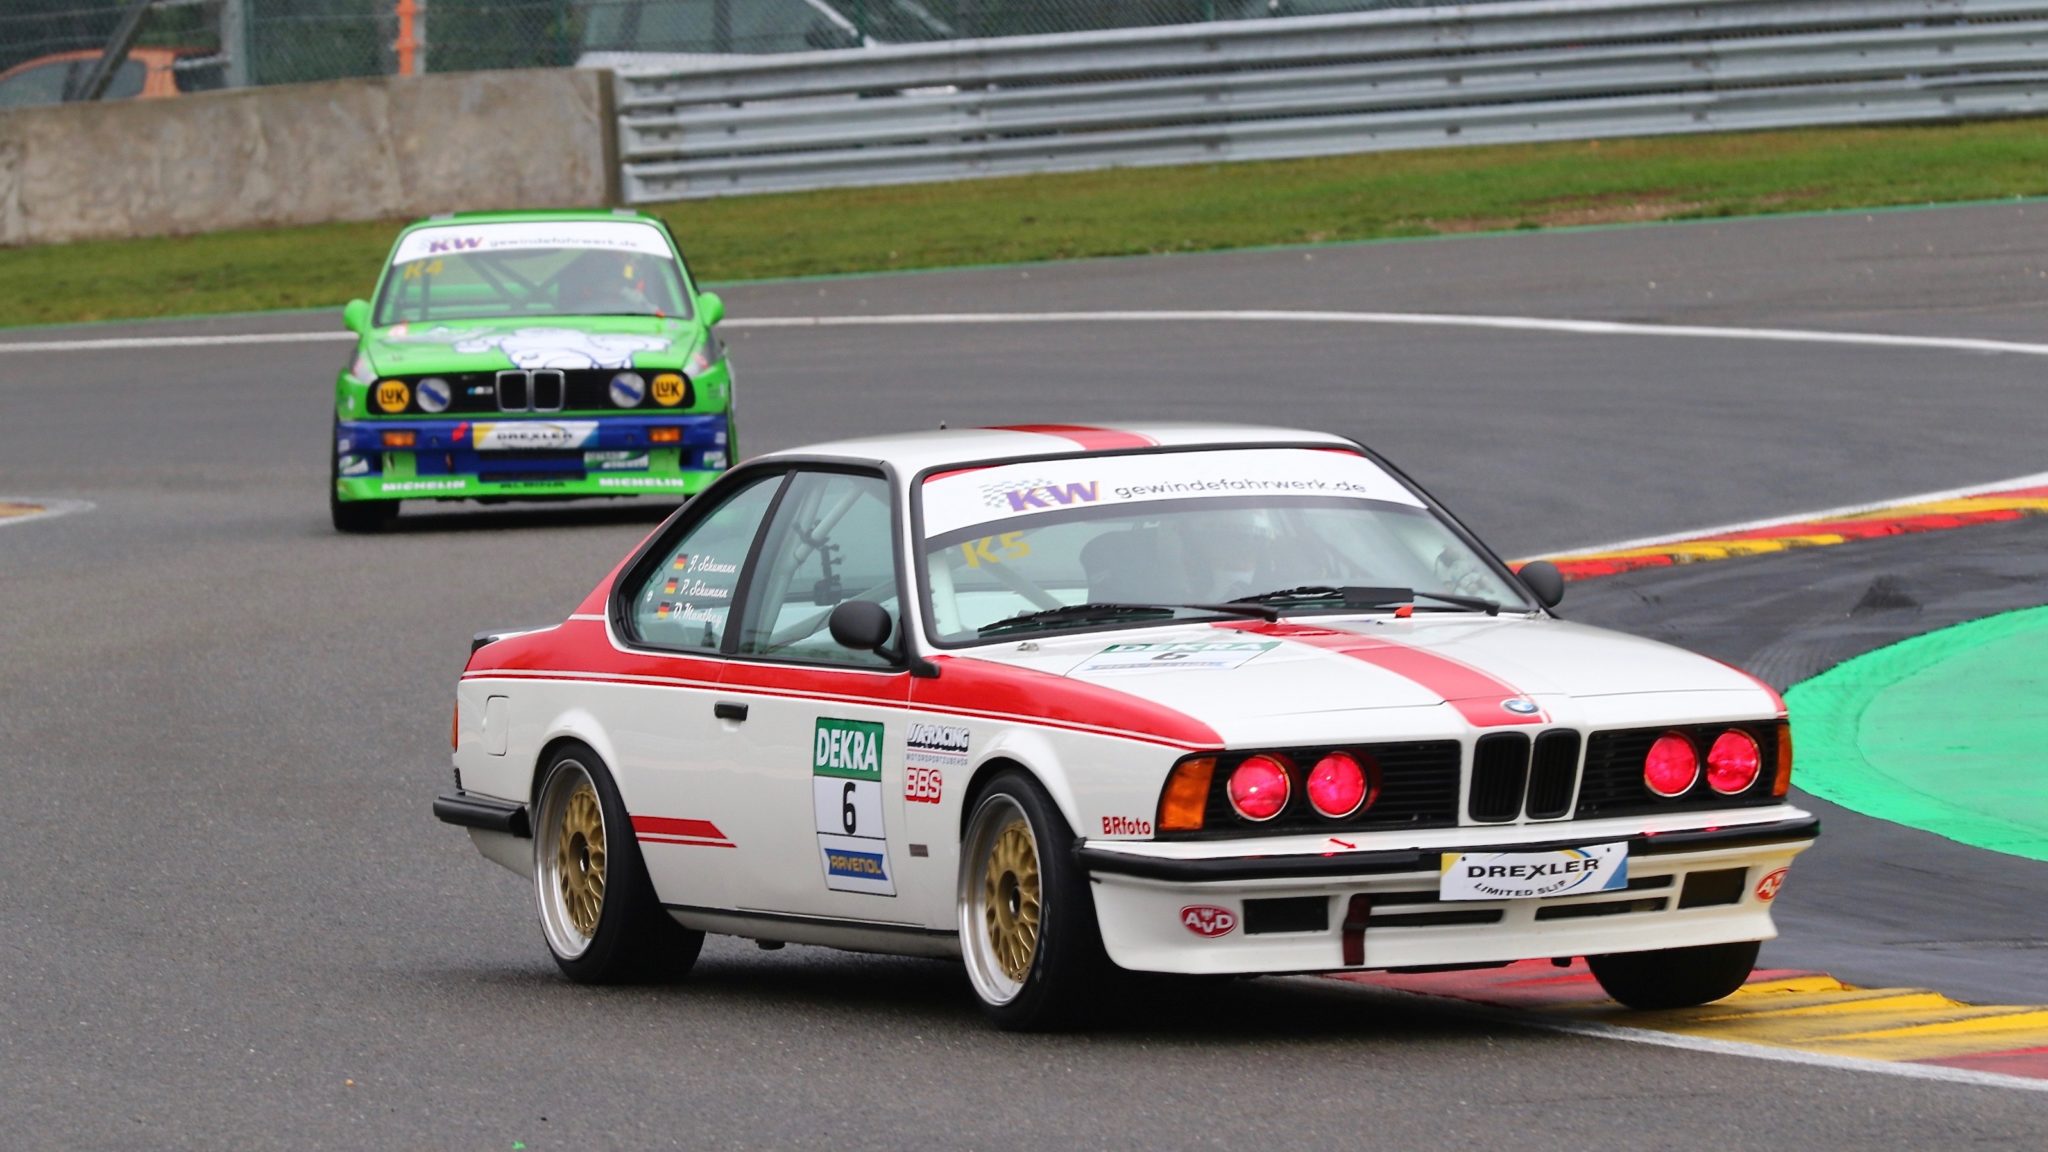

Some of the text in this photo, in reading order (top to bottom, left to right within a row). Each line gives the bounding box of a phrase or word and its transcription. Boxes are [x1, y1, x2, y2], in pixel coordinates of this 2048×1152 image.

[429, 237, 483, 253] KW
[382, 480, 466, 491] MICHELIN
[599, 477, 684, 487] MICHELIN
[1005, 478, 1367, 512] KW gewindefahrwerk.de
[961, 530, 1031, 569] K5
[816, 728, 878, 771] DEKRA
[905, 767, 942, 804] BBS
[842, 781, 857, 835] 6
[1102, 816, 1151, 835] BRfoto
[831, 854, 882, 874] RAVENOL
[1467, 858, 1600, 880] DREXLER
[1473, 879, 1567, 897] LIMITED SLIP
